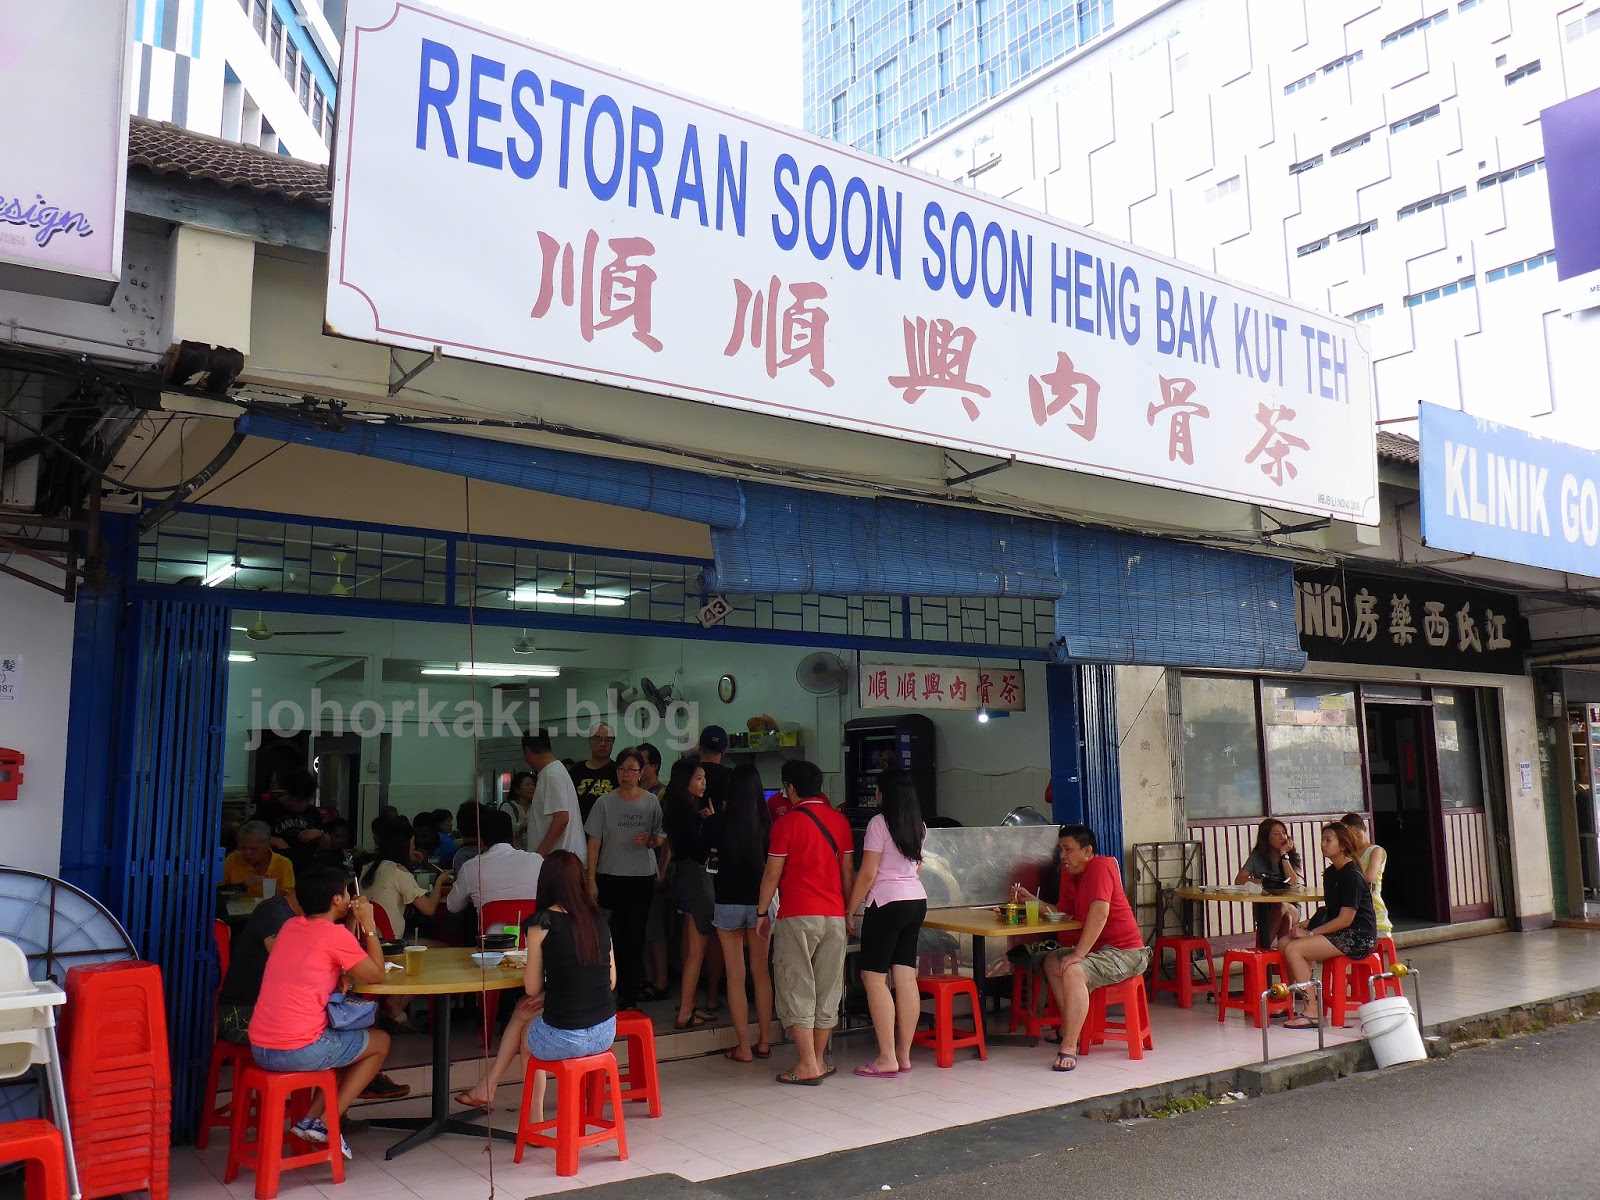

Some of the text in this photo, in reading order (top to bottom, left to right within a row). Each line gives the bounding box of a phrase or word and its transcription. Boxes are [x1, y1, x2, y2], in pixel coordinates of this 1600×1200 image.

[415, 37, 1349, 405] RESTORAN SOON SOON HENG BAK KUT TEH
[1444, 440, 1551, 537] KLINIK
[703, 600, 727, 623] 43
[1295, 581, 1343, 639] NG
[868, 670, 1019, 704] 順順興肉骨茶
